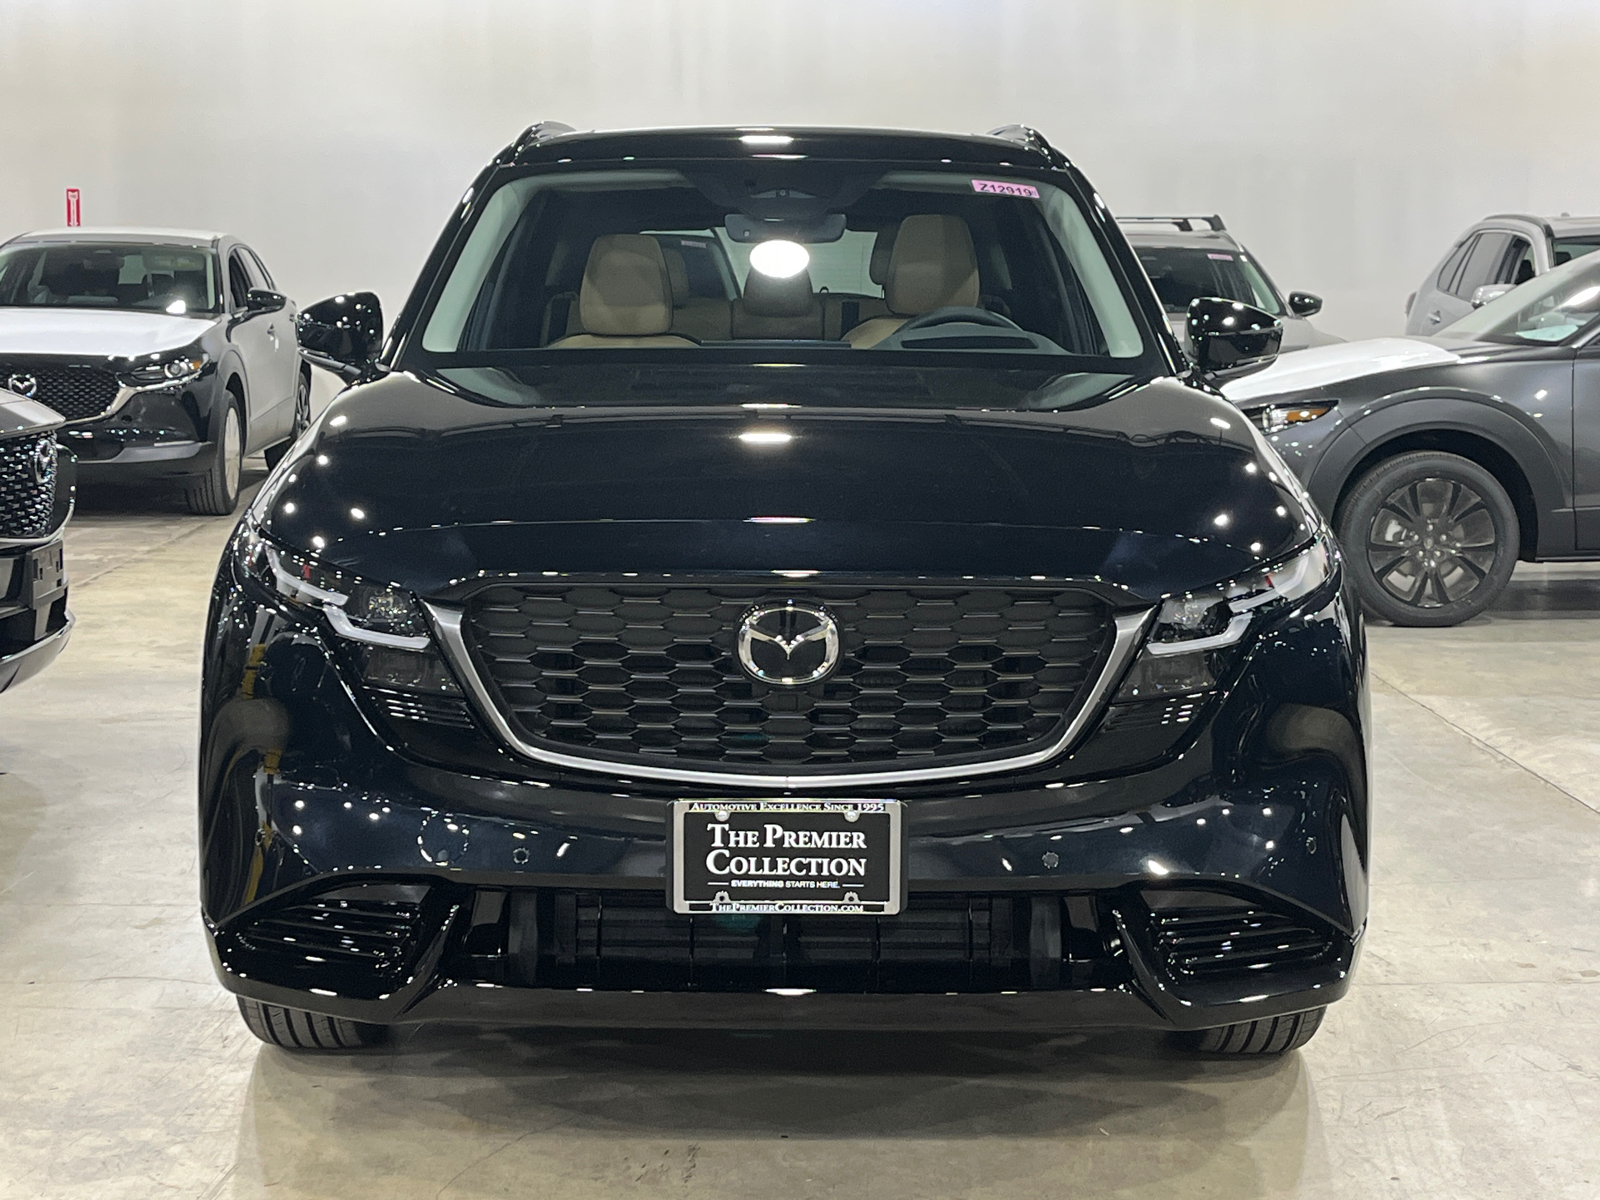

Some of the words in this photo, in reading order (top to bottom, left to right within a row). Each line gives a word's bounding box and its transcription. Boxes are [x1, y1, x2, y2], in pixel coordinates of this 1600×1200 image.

[979, 183, 1032, 196] Z12919
[690, 802, 757, 811] AUTOMOTIVE
[760, 802, 822, 811] EXCELLENCE
[823, 802, 853, 811] SINCE
[857, 803, 884, 811] 1995
[707, 823, 759, 848] THE
[763, 824, 867, 849] PREMIER
[706, 849, 867, 876] COLLECTION
[731, 880, 784, 888] EVERYTHING
